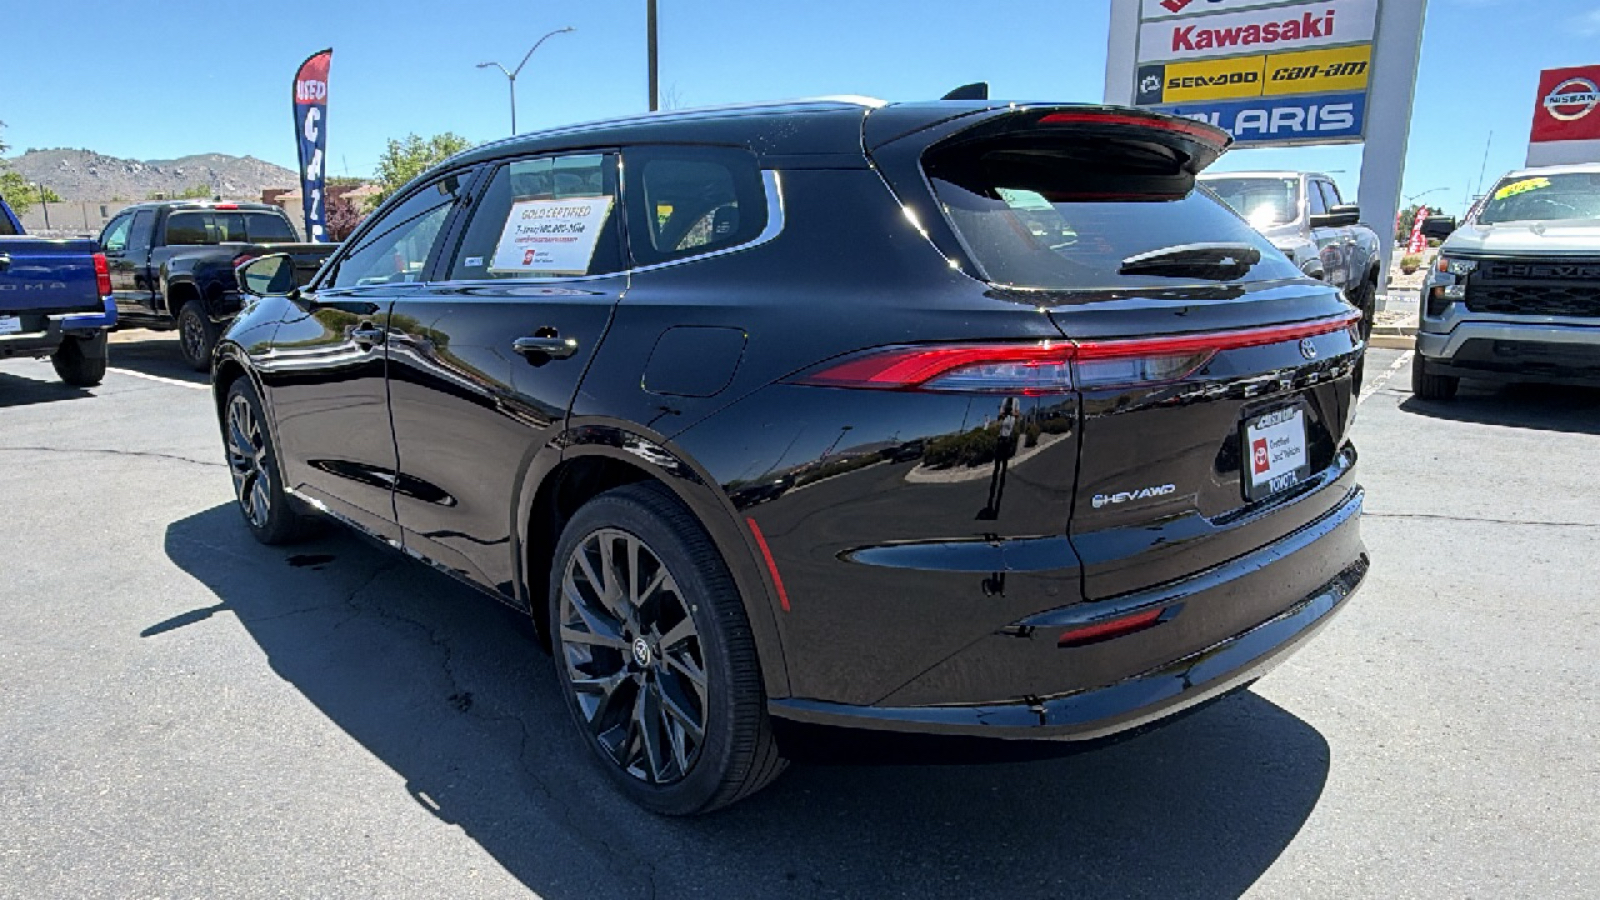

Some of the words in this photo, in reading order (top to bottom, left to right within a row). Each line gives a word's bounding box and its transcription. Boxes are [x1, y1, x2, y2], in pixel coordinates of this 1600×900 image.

[1172, 10, 1335, 51] Kawasaki
[296, 79, 326, 101] USED
[1549, 94, 1597, 104] NISSAN
[1270, 470, 1298, 493] TOYOTA
